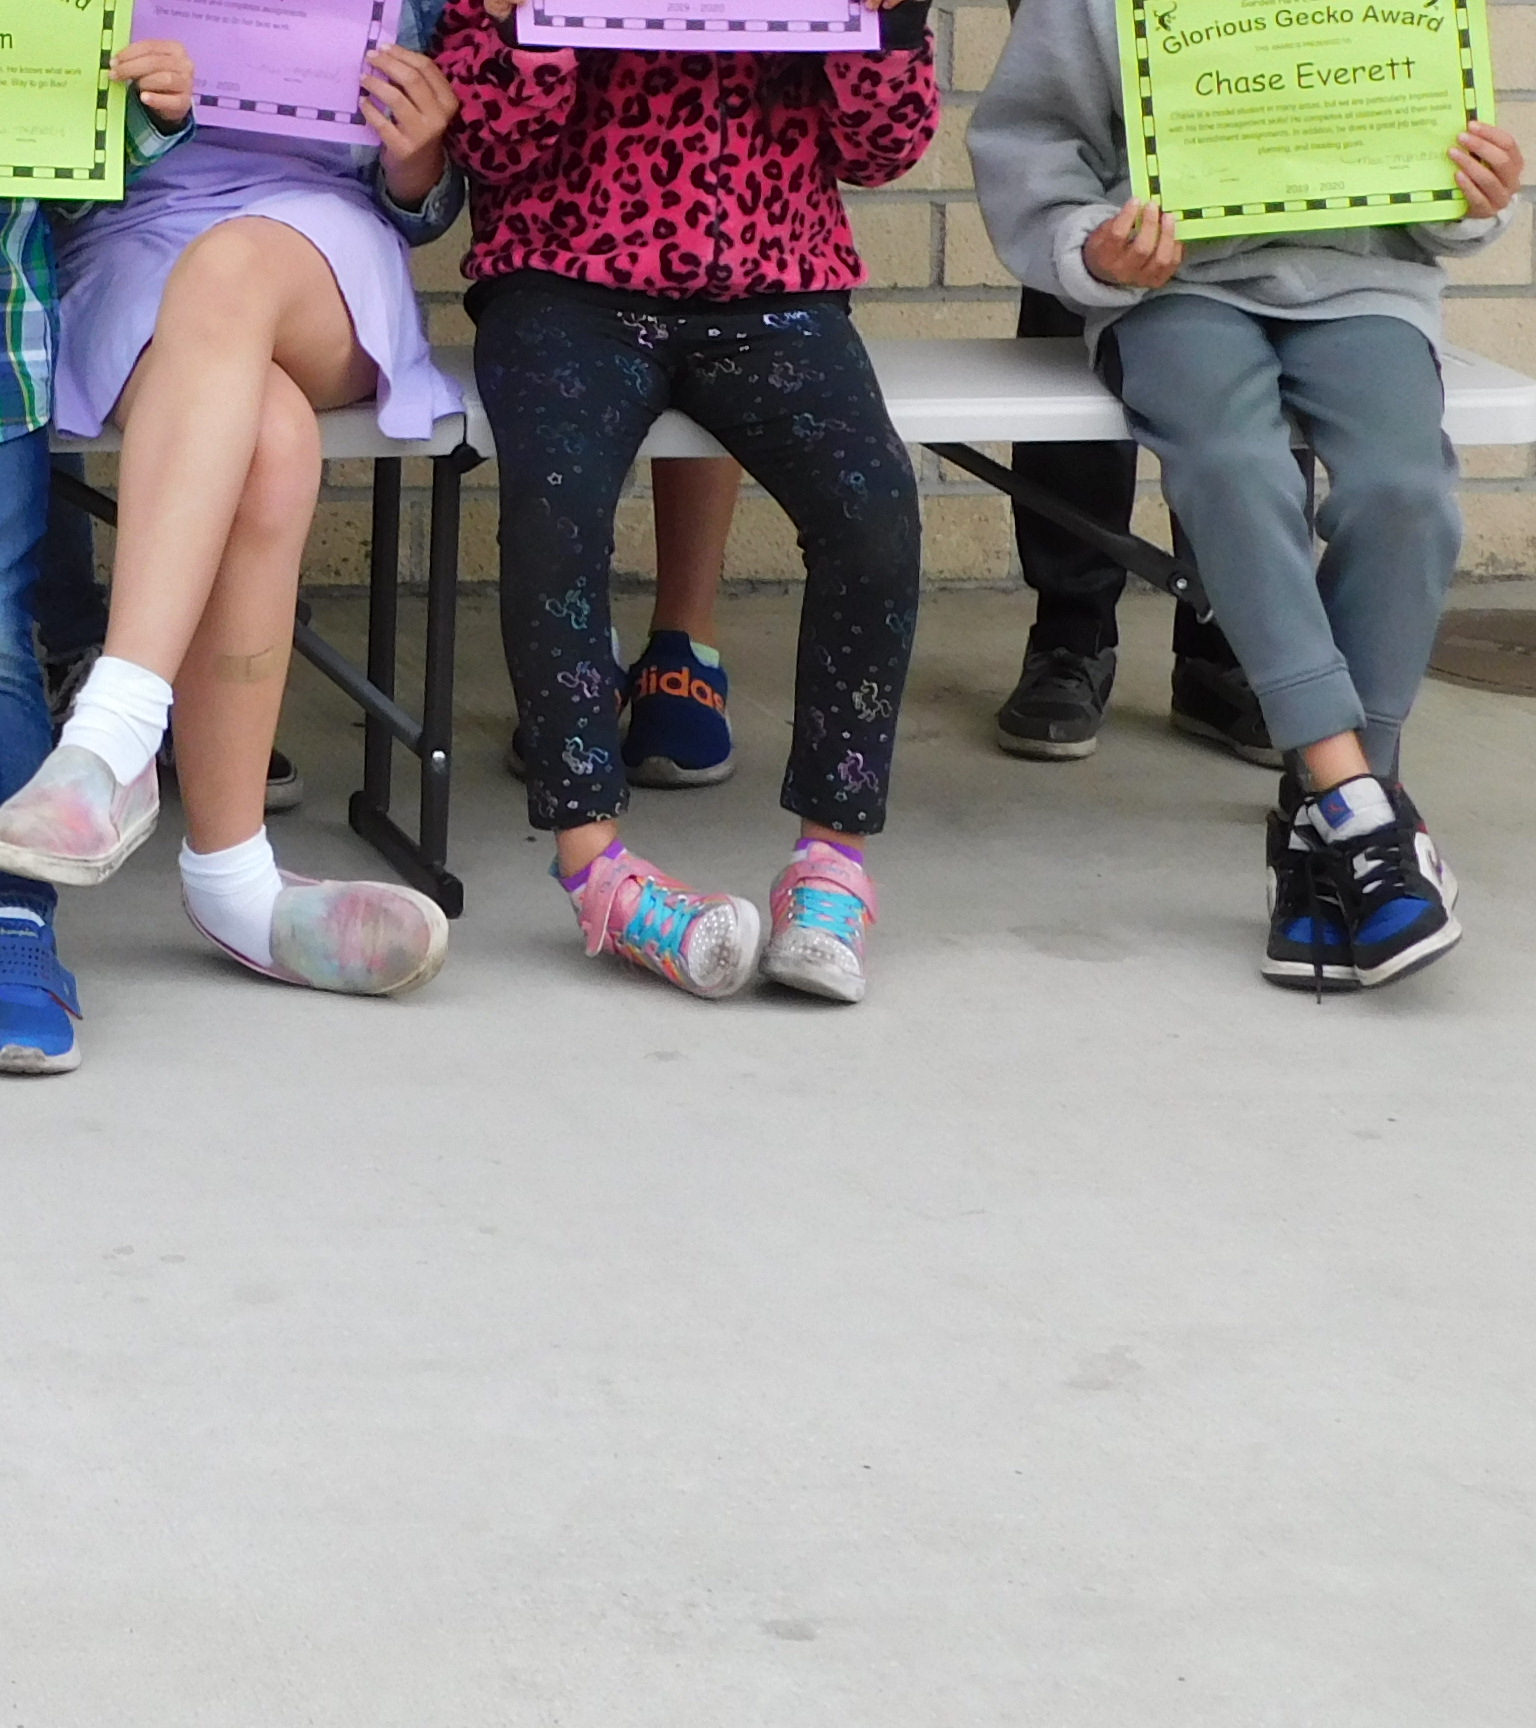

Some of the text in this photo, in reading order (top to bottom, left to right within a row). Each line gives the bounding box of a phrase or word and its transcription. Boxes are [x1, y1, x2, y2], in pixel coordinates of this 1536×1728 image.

[1163, 5, 1443, 54] Glorious Gecko Award
[1196, 56, 1415, 96] Chase Everett
